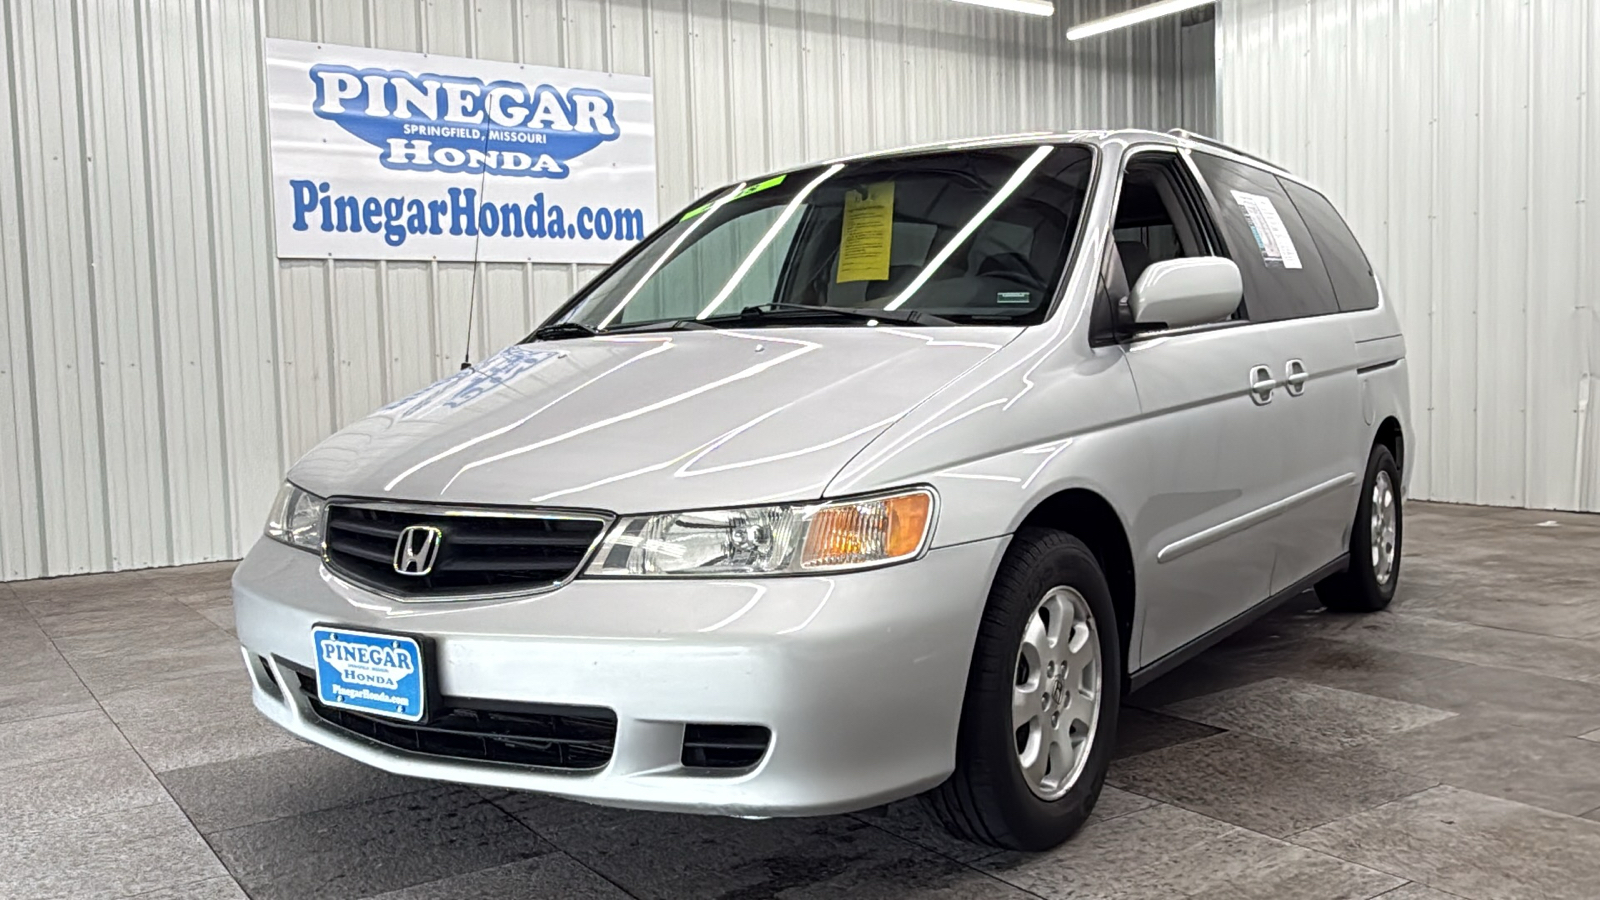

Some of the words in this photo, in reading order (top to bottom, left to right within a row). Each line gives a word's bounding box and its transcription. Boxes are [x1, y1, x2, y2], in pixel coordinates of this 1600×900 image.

[316, 71, 616, 136] PINEGAR
[402, 123, 486, 142] SPRINGFIELD,
[488, 130, 547, 145] MISSOURI
[385, 138, 565, 174] HONDA
[289, 179, 645, 247] PinegarHonda.com
[323, 643, 412, 670] PINEGAR
[343, 669, 395, 686] HONDA
[332, 684, 409, 706] PinegarHonda.com
